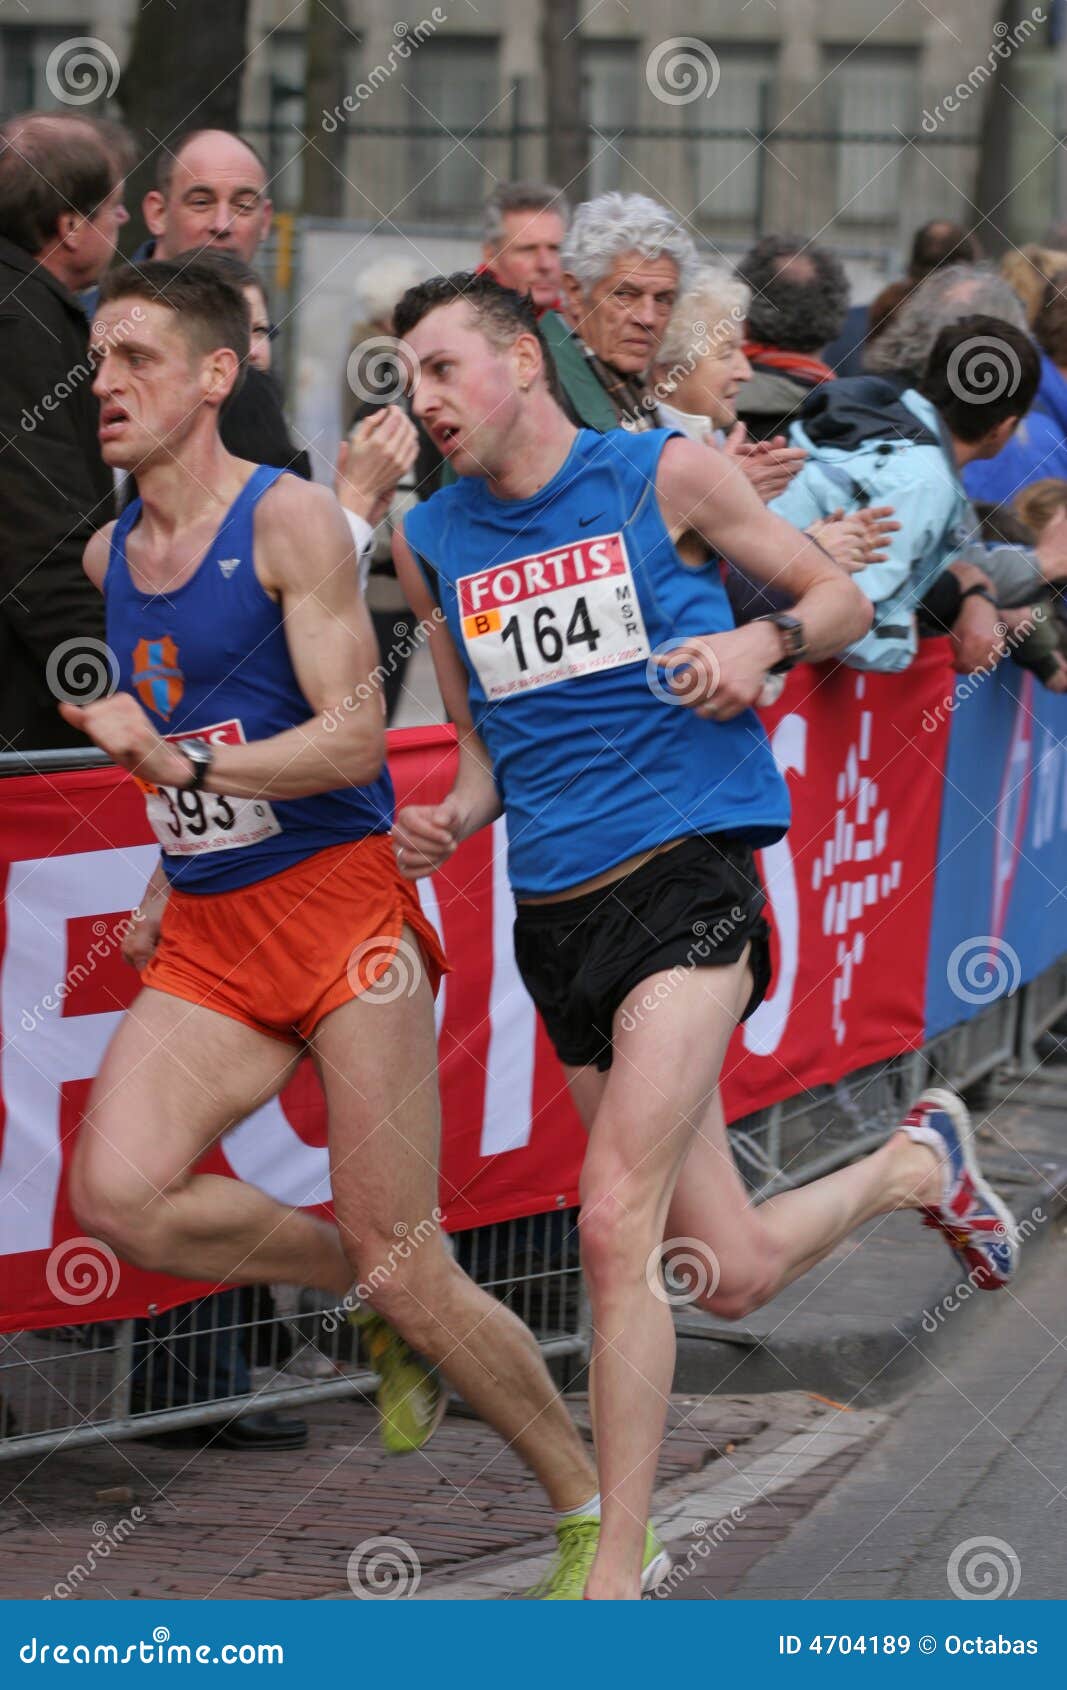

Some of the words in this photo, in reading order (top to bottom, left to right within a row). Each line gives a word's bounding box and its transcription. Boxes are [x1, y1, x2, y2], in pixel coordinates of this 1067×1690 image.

[470, 543, 611, 611] FORTIS
[475, 615, 490, 635] B
[501, 596, 601, 672] 164
[158, 786, 236, 838] 393
